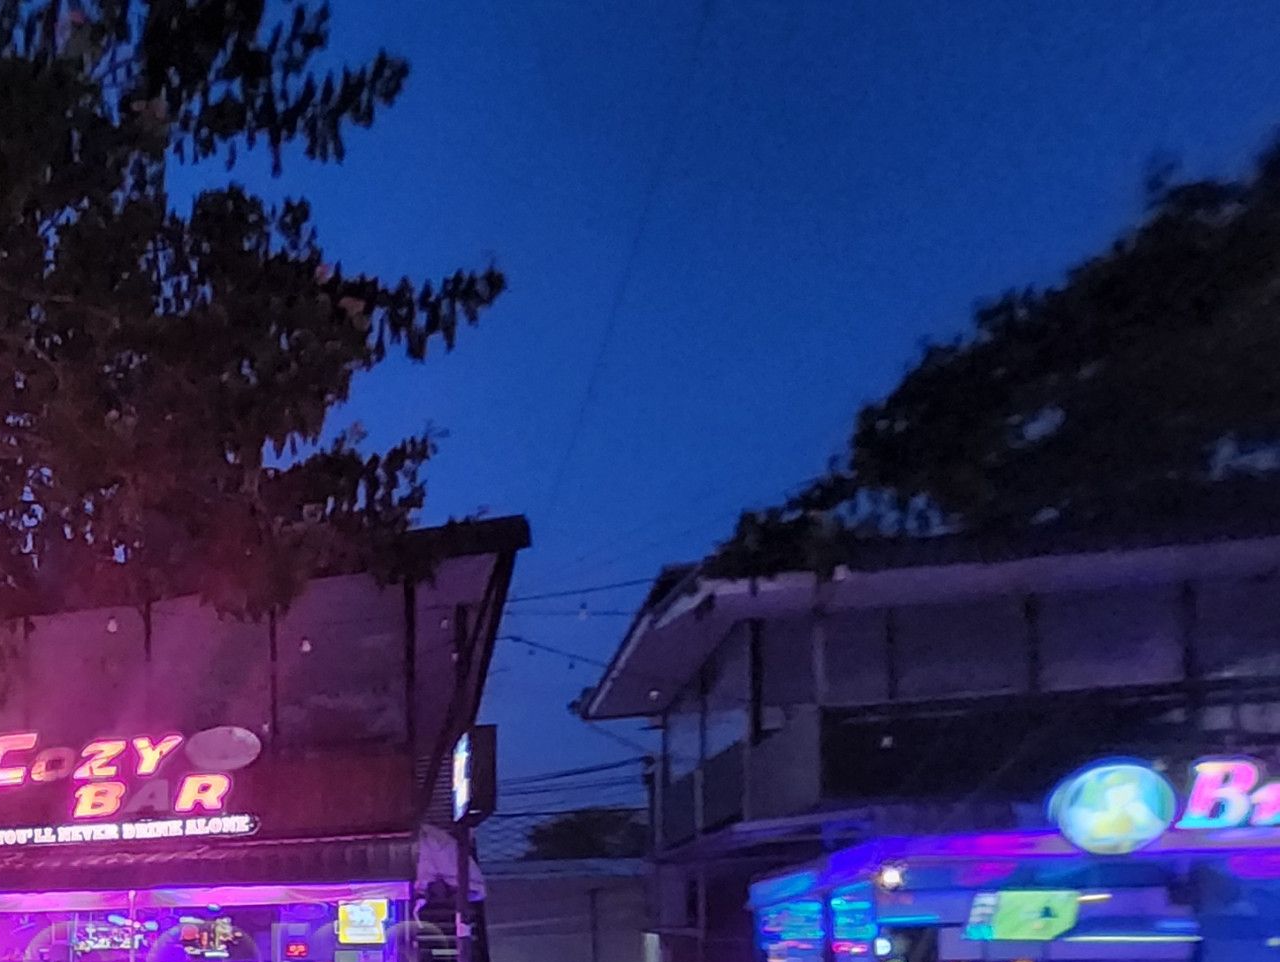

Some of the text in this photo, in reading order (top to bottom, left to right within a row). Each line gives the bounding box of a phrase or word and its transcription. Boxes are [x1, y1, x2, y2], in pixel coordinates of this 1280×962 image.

[73, 773, 231, 818] BAR
[57, 823, 119, 842] NEVER
[122, 819, 183, 839] DRINK
